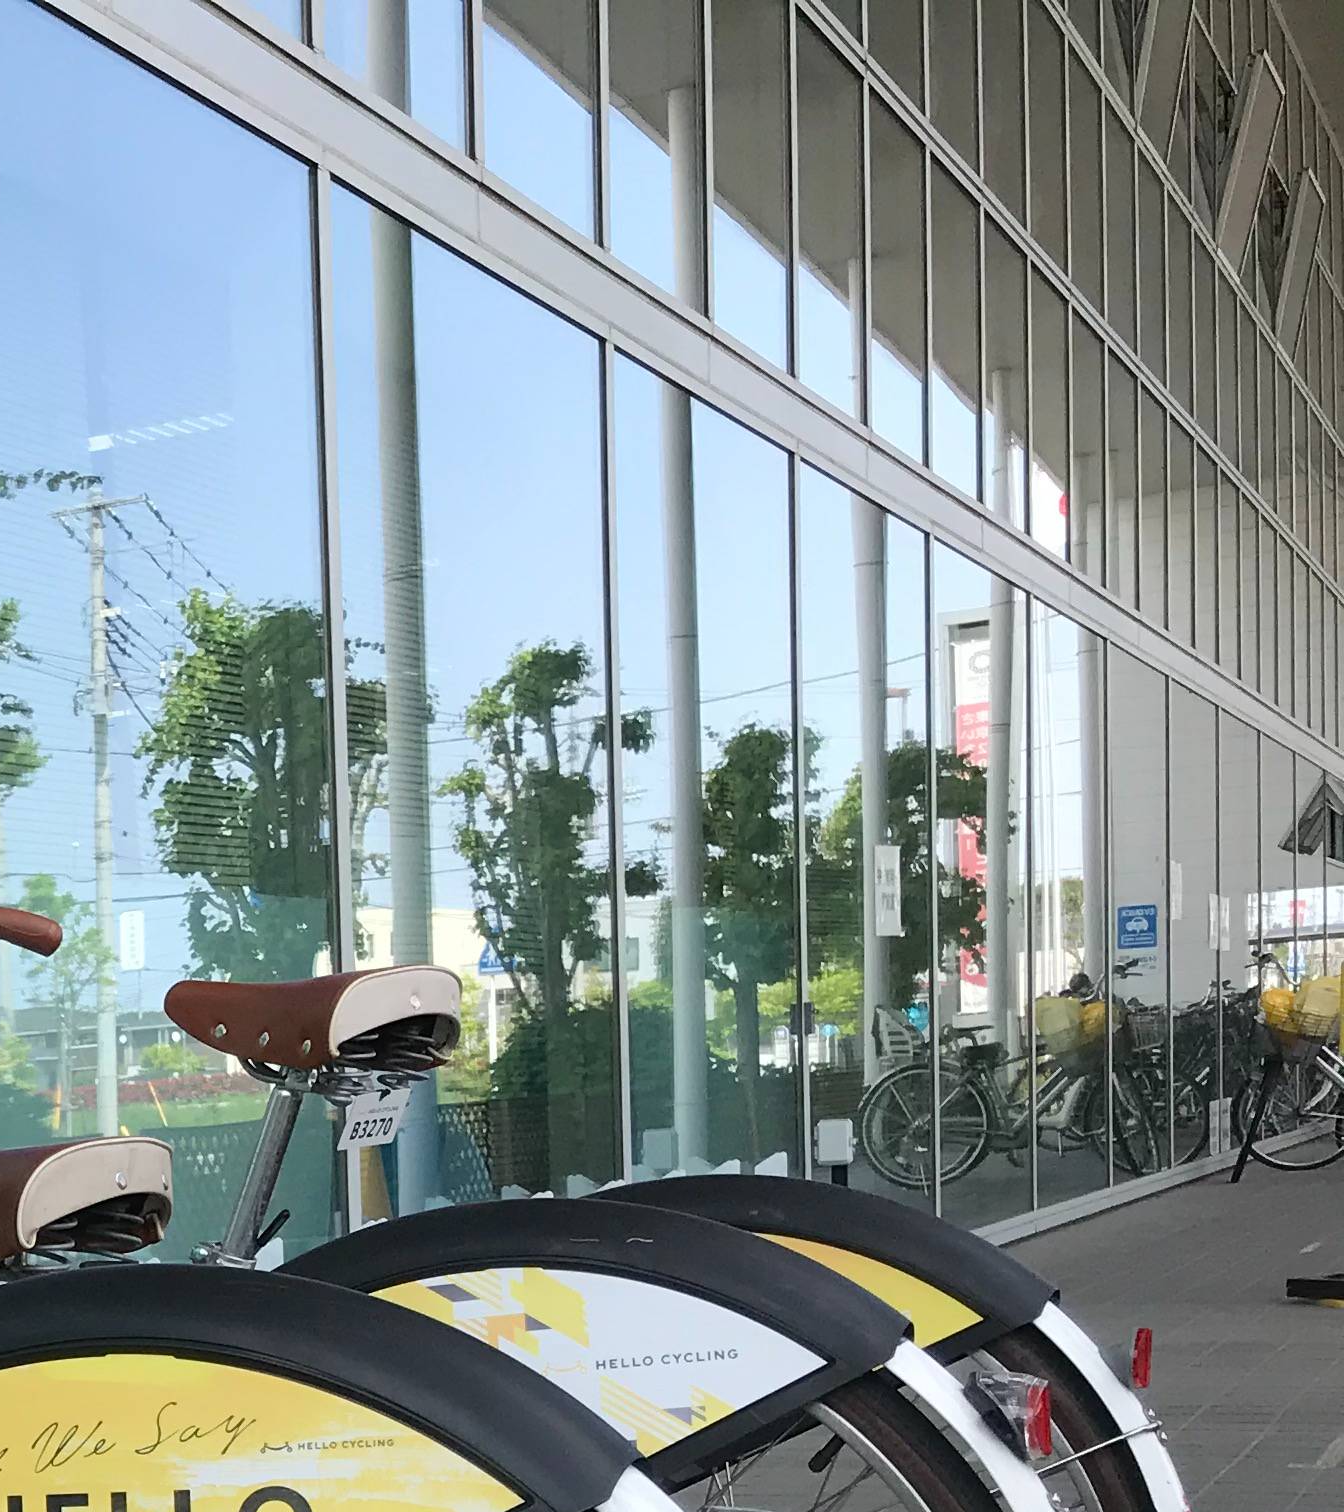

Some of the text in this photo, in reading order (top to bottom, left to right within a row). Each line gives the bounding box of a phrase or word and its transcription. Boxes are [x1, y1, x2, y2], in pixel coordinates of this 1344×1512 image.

[349, 1117, 393, 1140] B3270
[595, 1348, 740, 1371] HELLO CYCLING
[31, 1421, 117, 1474] We
[134, 1401, 257, 1456] Say
[297, 1438, 395, 1451] HELLO CYCLING
